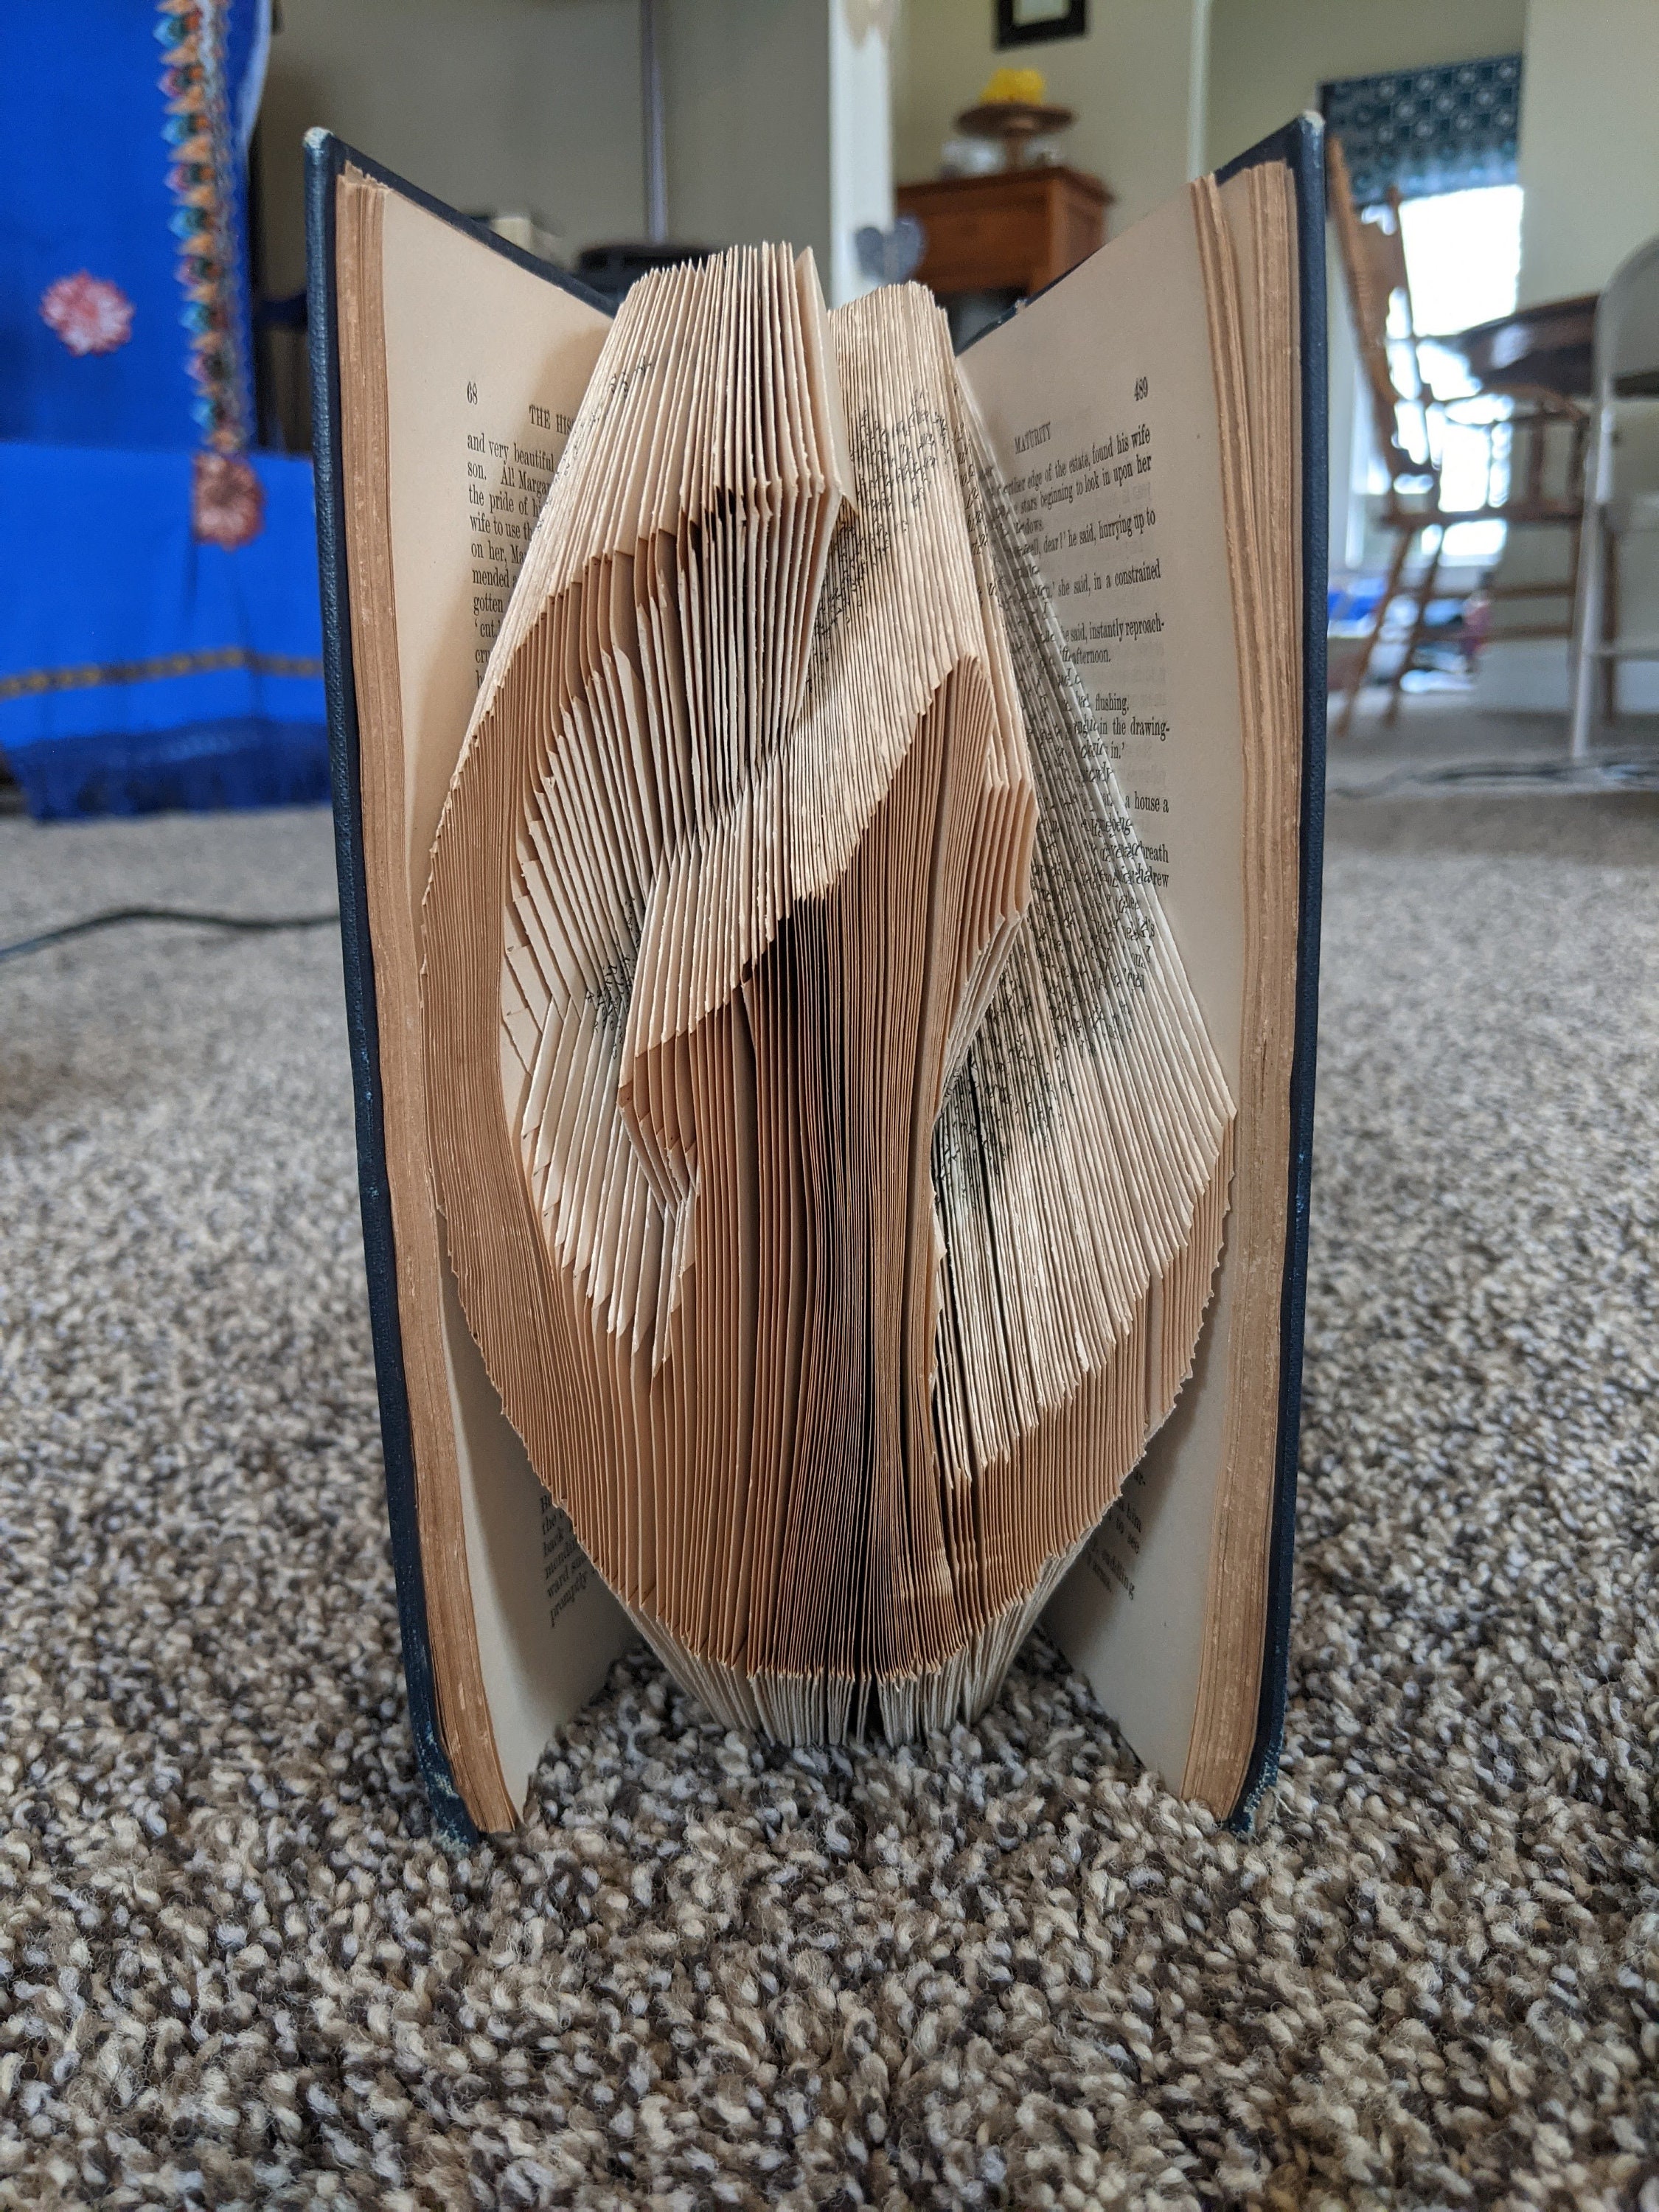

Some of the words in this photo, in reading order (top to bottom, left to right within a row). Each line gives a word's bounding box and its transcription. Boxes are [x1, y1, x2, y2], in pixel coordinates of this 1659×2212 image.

[467, 381, 478, 405] 68
[1134, 377, 1148, 401] 489
[529, 404, 551, 430] THE
[467, 433, 485, 453] and
[489, 440, 509, 465] very
[1014, 421, 1051, 454] MATURITY
[467, 462, 487, 480] son.
[1027, 470, 1042, 492] edge
[1045, 463, 1052, 482] of
[1055, 459, 1066, 478] the
[1068, 451, 1091, 473] estate,
[1092, 435, 1113, 465] found
[1116, 432, 1129, 455] his
[1131, 423, 1150, 448] wife
[1020, 498, 1037, 514] stars
[1040, 483, 1074, 510] beginning
[1077, 479, 1083, 495] to
[1085, 470, 1100, 493] look
[1102, 467, 1110, 487] in
[1113, 461, 1133, 487] upon
[1136, 453, 1152, 474] her
[469, 484, 484, 507] the
[490, 490, 514, 514] pride
[518, 497, 529, 515] of
[470, 511, 490, 534] wife
[493, 516, 504, 537] to
[505, 523, 521, 539] use
[1068, 529, 1077, 547] he
[1079, 523, 1096, 546] said,
[1098, 514, 1133, 540] hurrying
[1134, 513, 1144, 535] up
[1146, 507, 1156, 526] to
[471, 543, 484, 558] on
[488, 540, 508, 568] her,
[472, 567, 510, 588] mended
[1058, 579, 1070, 597] she
[1074, 574, 1091, 597] said,
[1093, 572, 1102, 591] in
[1106, 575, 1111, 588] a
[1114, 558, 1161, 587] constrained
[473, 593, 504, 616] gotten
[1070, 622, 1088, 644] said,
[1090, 618, 1124, 642] instantly
[1125, 613, 1165, 640] reproach-
[1095, 692, 1130, 716] flushing.
[1099, 717, 1107, 735] in
[1113, 716, 1126, 736] the
[1130, 716, 1170, 742] drawing-
[1125, 794, 1130, 809] a
[1134, 790, 1160, 812] house
[1163, 799, 1169, 813] a
[1140, 841, 1169, 863] breath
